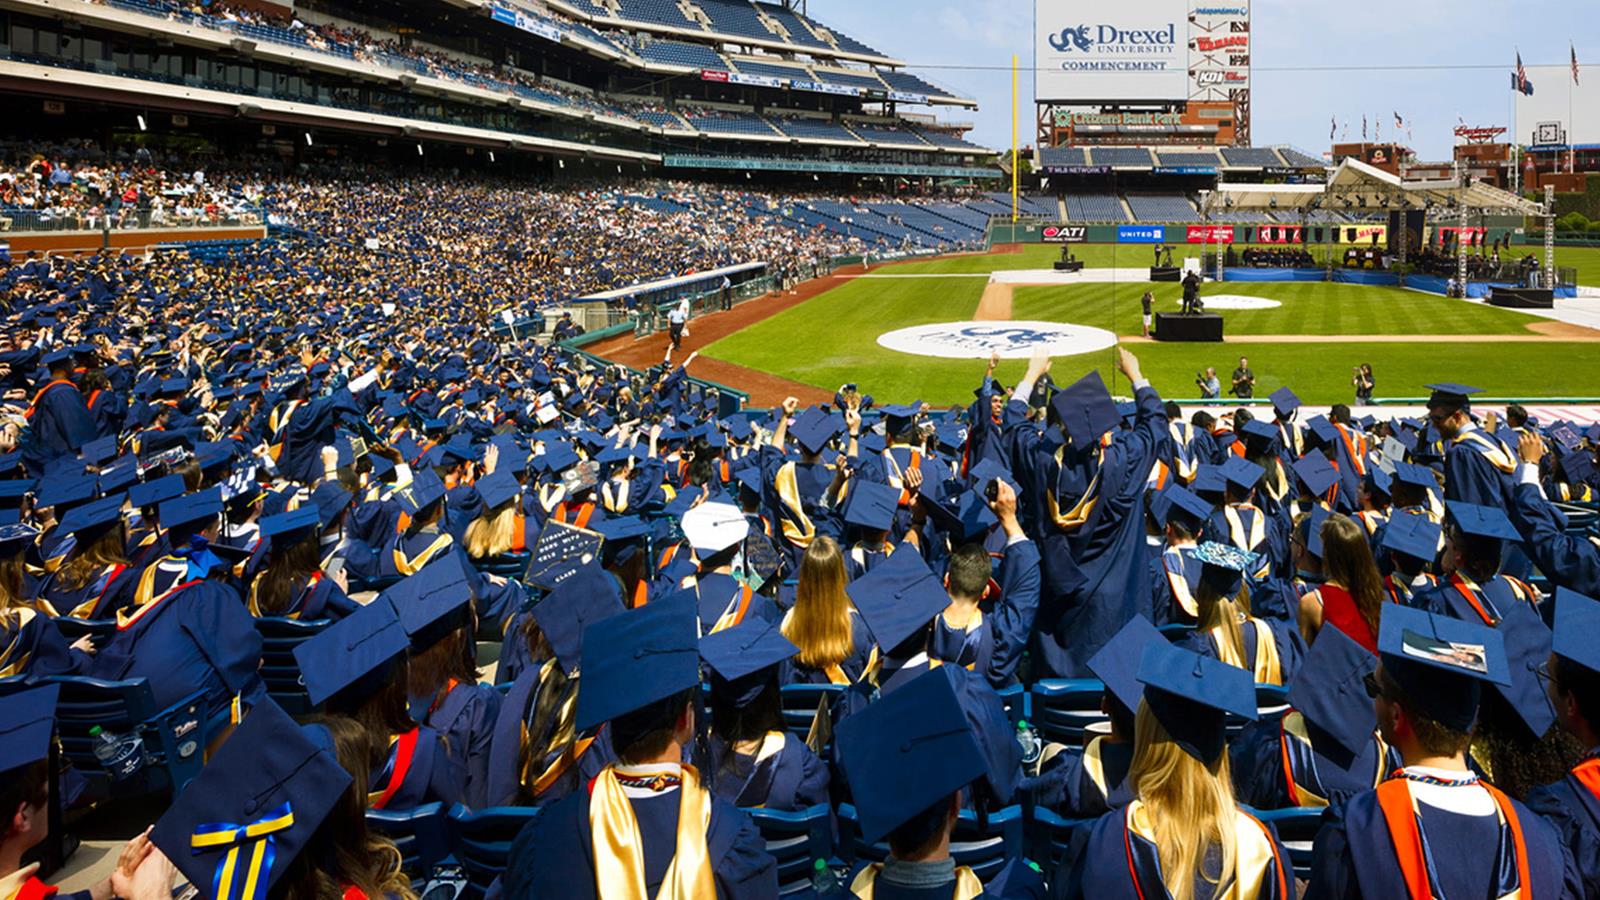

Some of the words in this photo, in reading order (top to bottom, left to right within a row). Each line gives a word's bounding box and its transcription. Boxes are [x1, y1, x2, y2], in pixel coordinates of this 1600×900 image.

[1097, 23, 1176, 45] Drexel
[1097, 45, 1174, 53] UNIVERSITY
[1062, 61, 1167, 71] COMMENCEMENT
[1073, 112, 1121, 125] Citizens
[1123, 113, 1153, 125] Bank
[1154, 113, 1182, 125] Park
[1058, 227, 1085, 237] ATI
